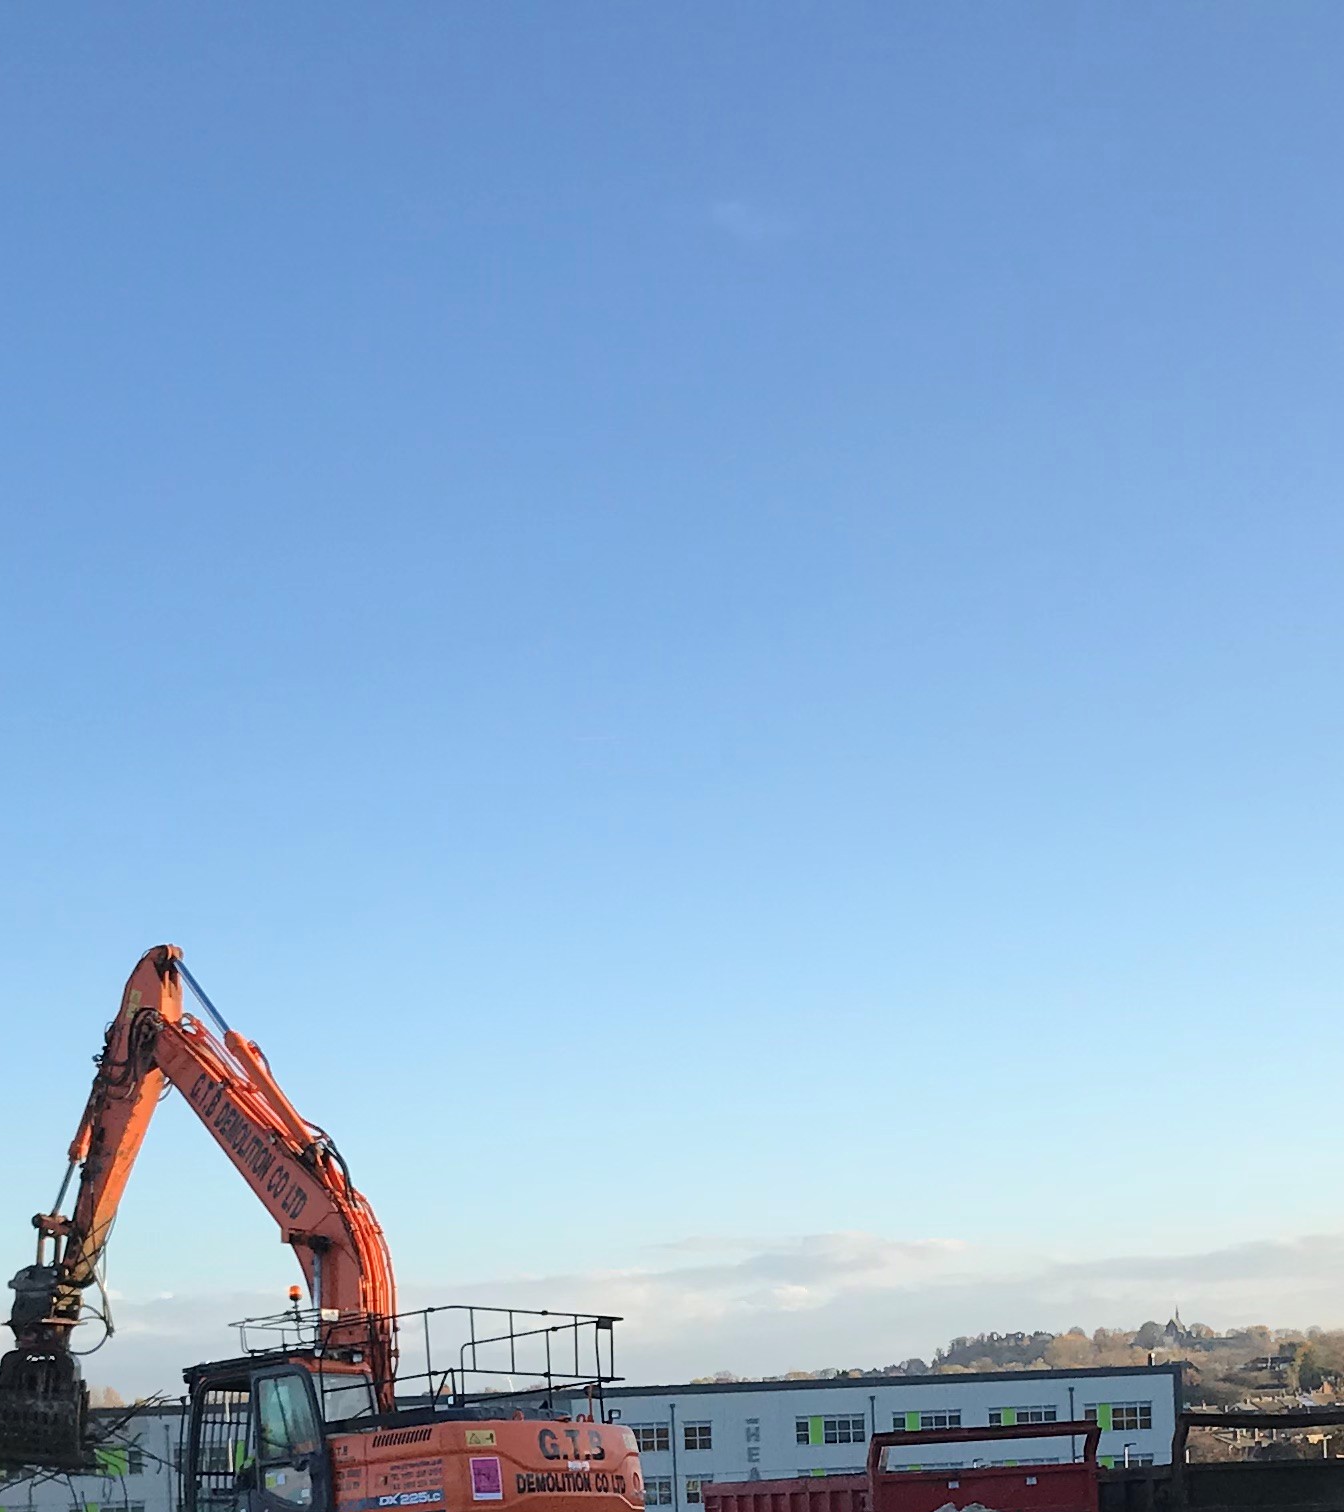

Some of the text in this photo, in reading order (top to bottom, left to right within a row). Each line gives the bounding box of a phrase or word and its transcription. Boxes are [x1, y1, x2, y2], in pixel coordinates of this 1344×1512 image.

[213, 1101, 277, 1182] DEMOLITION
[266, 1164, 291, 1200] CO
[280, 1182, 308, 1220] LTD
[516, 1471, 591, 1495] DEMOLITION
[594, 1473, 609, 1494] CO
[612, 1474, 626, 1494] LTD
